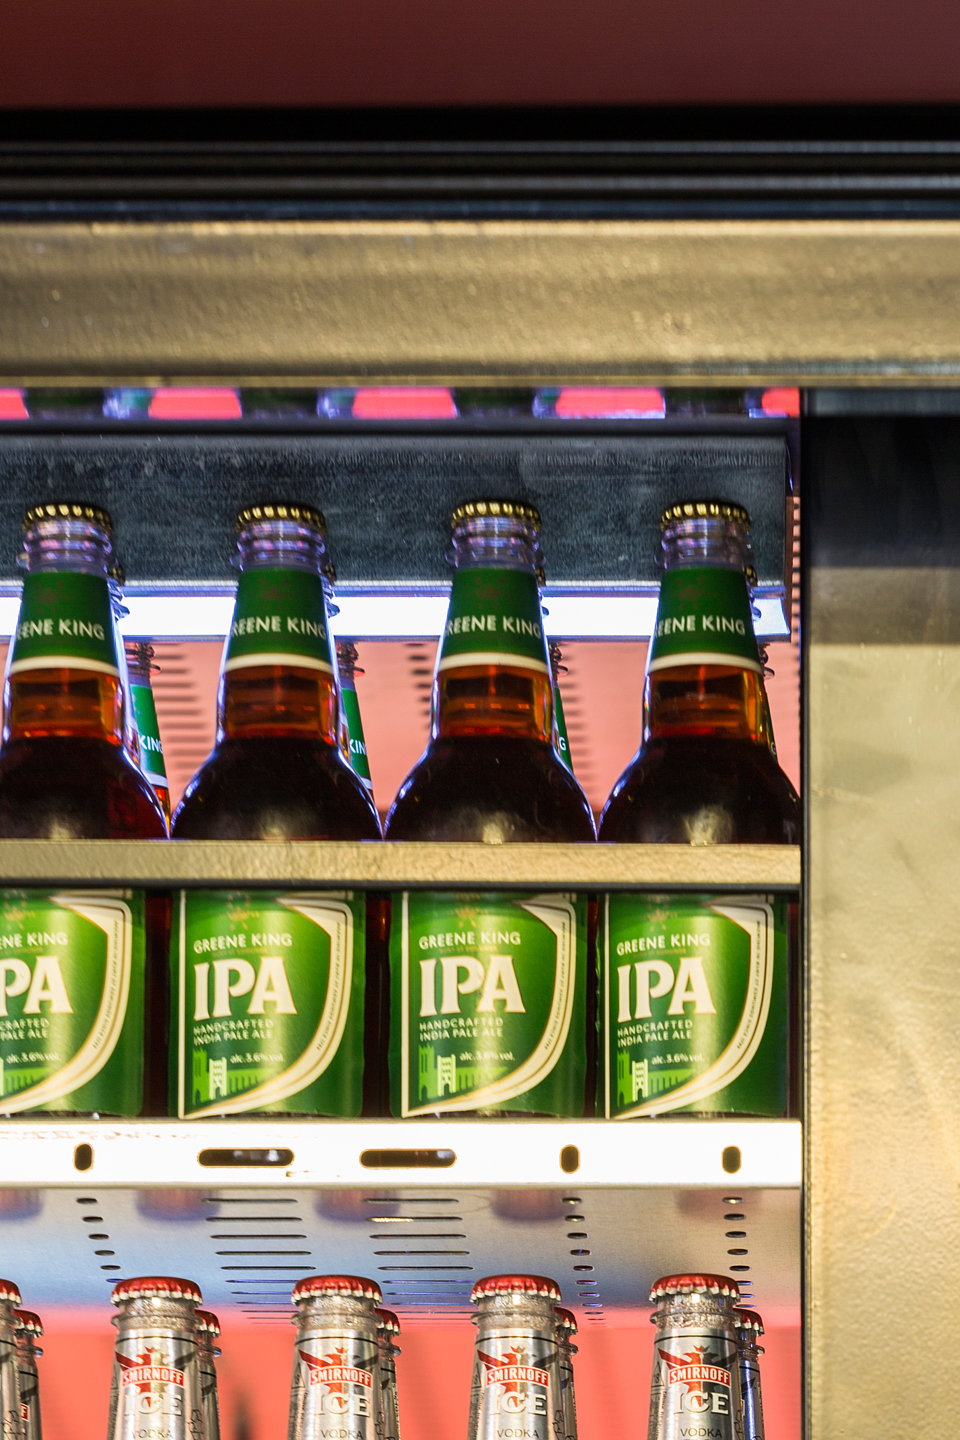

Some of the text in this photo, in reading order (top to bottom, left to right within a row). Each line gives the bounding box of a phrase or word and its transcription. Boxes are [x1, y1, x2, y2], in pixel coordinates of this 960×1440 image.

[59, 618, 105, 640] KING
[287, 616, 327, 640] KING
[502, 616, 541, 640] KING
[702, 615, 746, 636] KING
[27, 932, 69, 946] KING
[193, 933, 292, 954] GREENE KING
[418, 932, 475, 950] GREENE
[480, 931, 521, 945] KING
[617, 934, 666, 956] GREENE
[671, 933, 711, 948] KING
[0, 955, 74, 1017] PA
[193, 956, 298, 1021] IPA
[419, 954, 526, 1017] IPA
[617, 957, 716, 1023] IPA
[193, 1018, 274, 1035] HANDCRAFTED
[419, 1017, 504, 1032] HANDCRAFTED
[419, 1026, 503, 1042] INDIA PALE ALE
[617, 1019, 693, 1038] HANDCRAFTED
[224, 1030, 248, 1041] PALE
[252, 1029, 273, 1039] ALE
[617, 1030, 692, 1048] INDIA PALE ALE
[123, 1367, 183, 1384] SMIRNOFF
[311, 1368, 371, 1385] SMIRNOFF
[488, 1367, 547, 1384] SMIRNOFF
[670, 1367, 729, 1384] SMIRNOFF
[490, 1391, 548, 1416] ICE
[673, 1390, 730, 1415] ICE
[320, 1429, 364, 1440] VODKA
[496, 1428, 539, 1439] VODKA
[680, 1428, 723, 1438] VODKA
